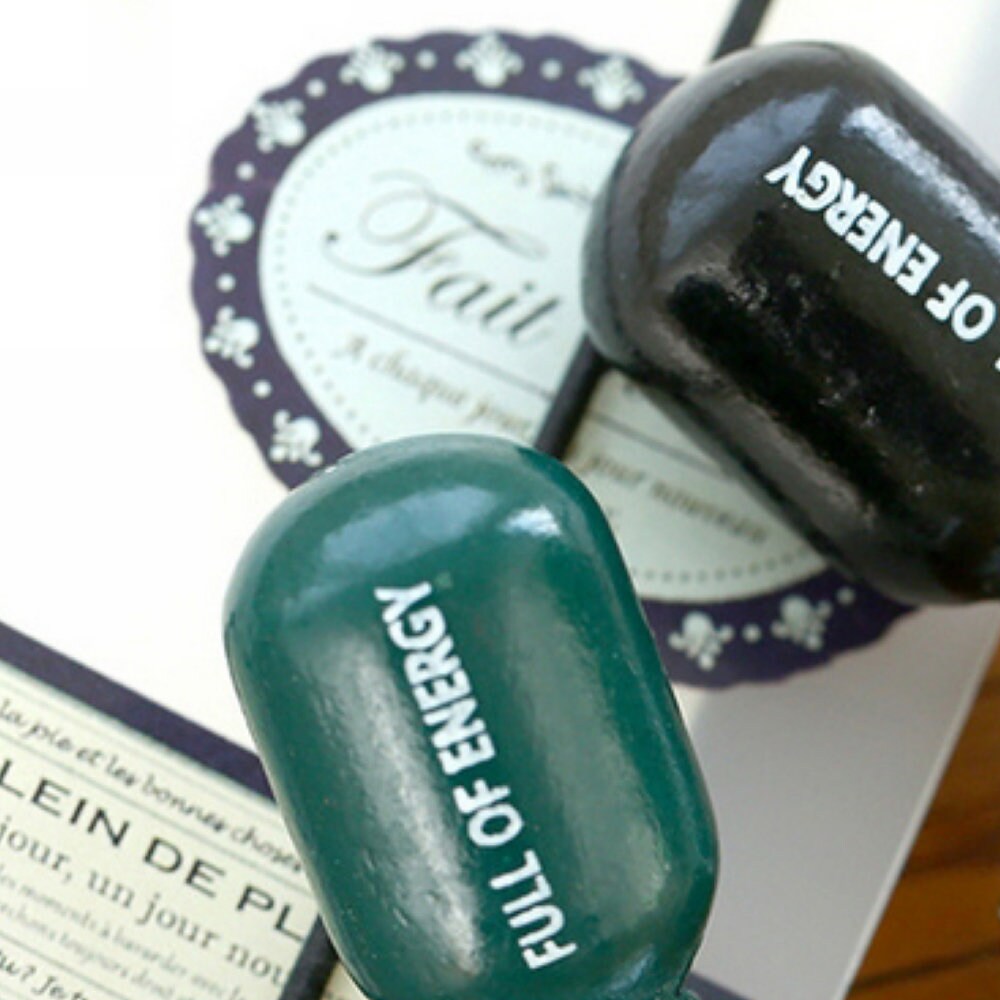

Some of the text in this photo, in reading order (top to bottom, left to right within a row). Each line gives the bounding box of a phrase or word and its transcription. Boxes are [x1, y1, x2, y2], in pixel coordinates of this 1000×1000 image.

[763, 144, 943, 297] ENERGY
[924, 278, 997, 342] OF
[76, 744, 105, 767] et
[105, 752, 137, 787] les
[140, 772, 227, 834] bonnes
[374, 581, 578, 970] FULL OF ENERGY
[0, 757, 306, 943] LEIN DE PL
[87, 868, 136, 911] un
[136, 890, 223, 949] jour
